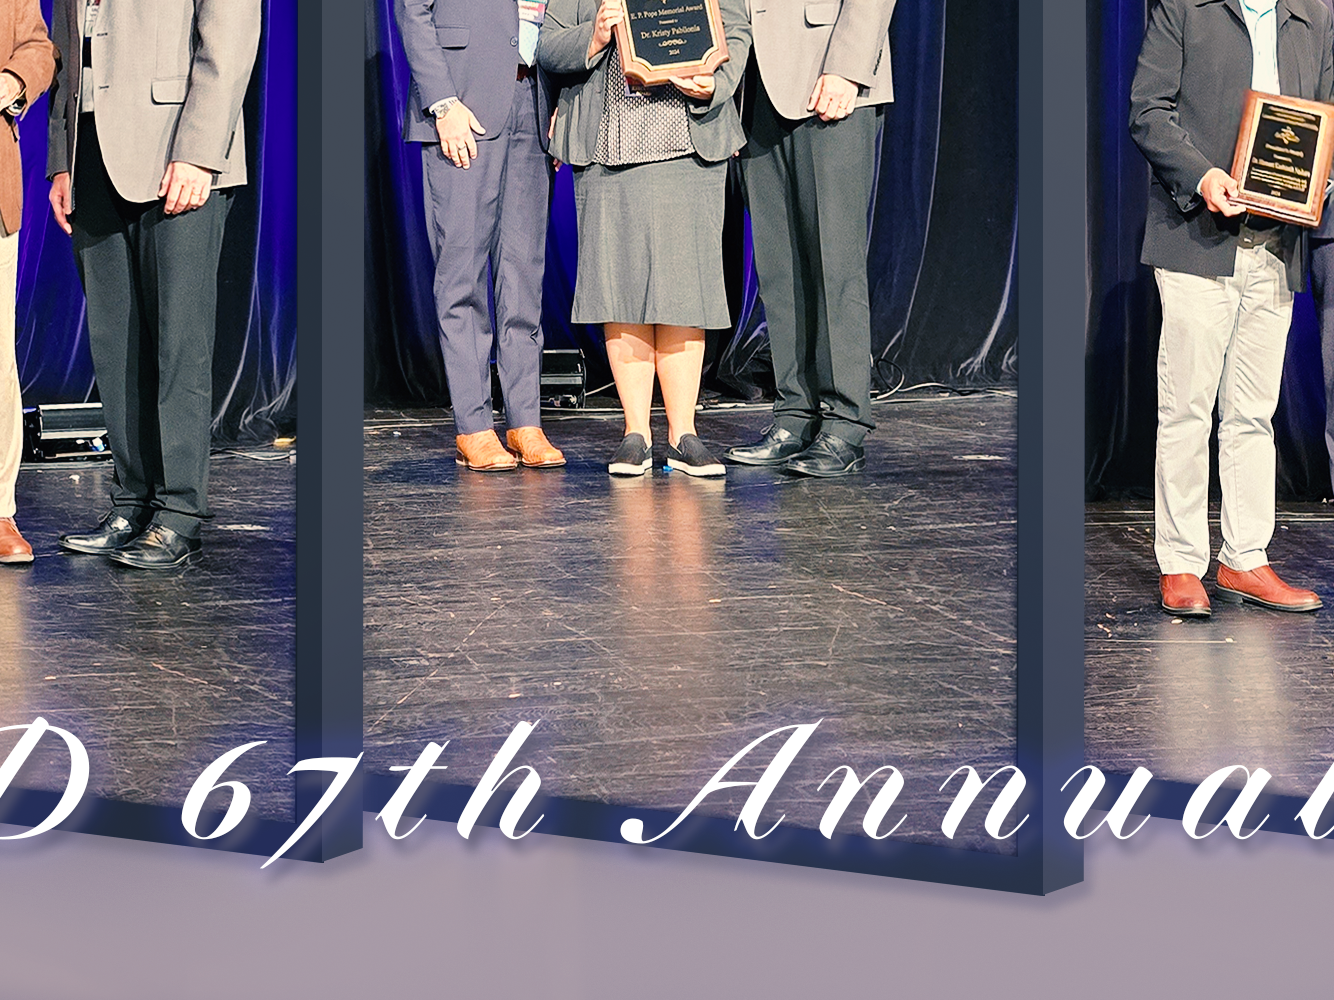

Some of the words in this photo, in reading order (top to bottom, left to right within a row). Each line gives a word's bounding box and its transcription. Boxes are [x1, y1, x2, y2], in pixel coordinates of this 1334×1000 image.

[658, 6, 684, 16] Memorial
[686, 4, 703, 12] Award
[652, 29, 671, 37] Kristy
